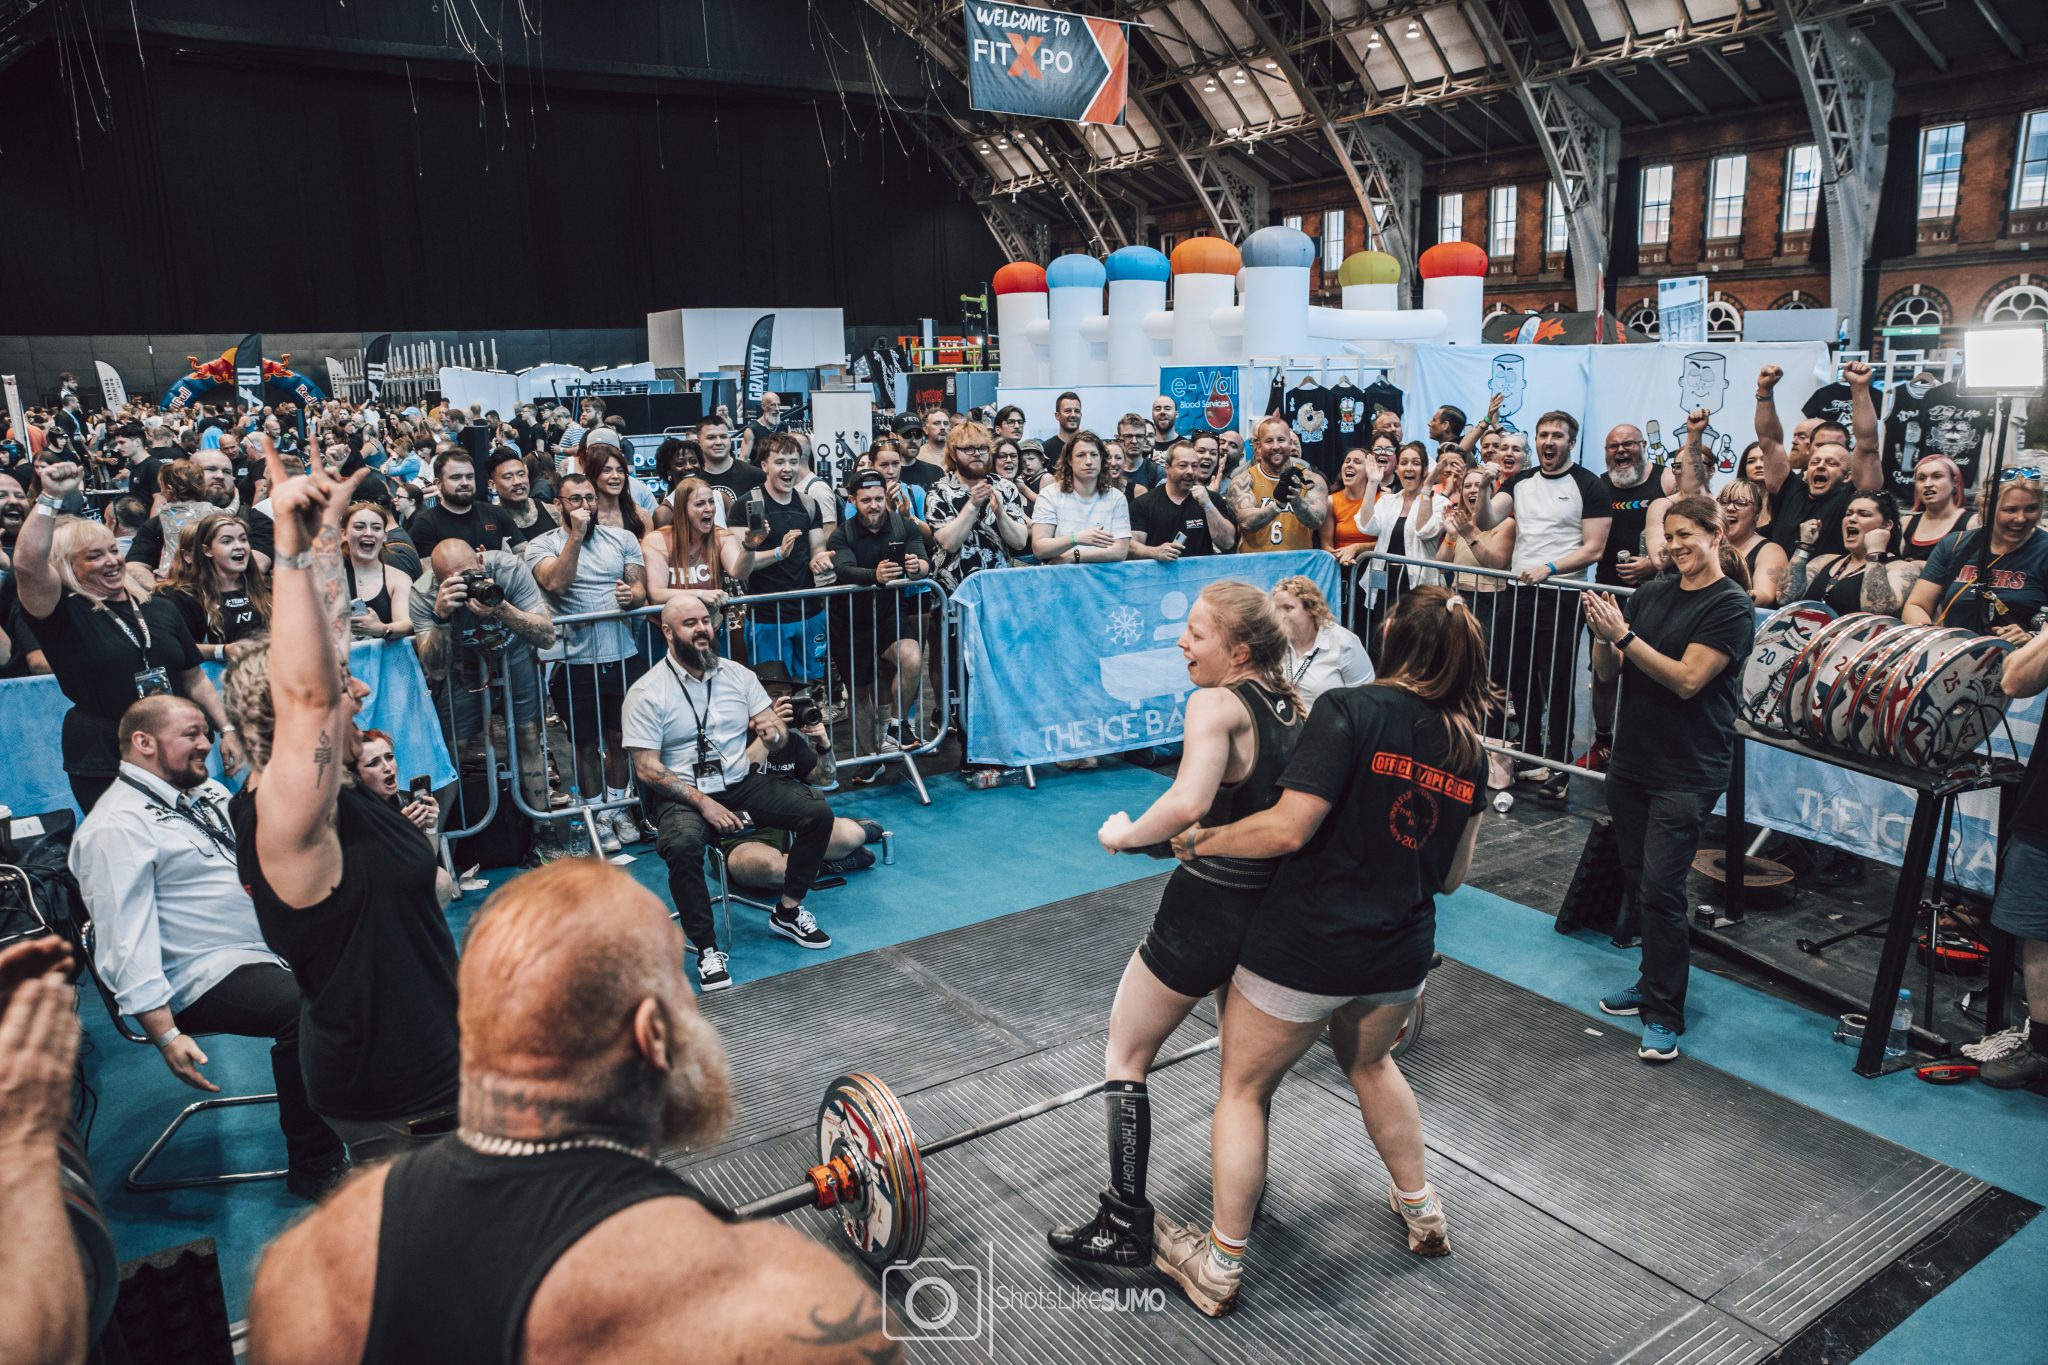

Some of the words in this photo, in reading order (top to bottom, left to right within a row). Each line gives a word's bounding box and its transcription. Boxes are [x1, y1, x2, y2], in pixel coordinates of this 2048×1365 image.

[977, 6, 1050, 32] WELCOME
[1054, 15, 1071, 36] TO
[973, 32, 1073, 80] FITXPO
[749, 344, 766, 401] GRAVITY
[1171, 370, 1238, 397] e-Val
[1202, 400, 1229, 408] Services
[1271, 521, 1283, 545] 6
[1757, 647, 1777, 665] 20
[1834, 655, 1848, 672] 2
[1943, 671, 1960, 694] 25
[1039, 720, 1092, 752] THE
[1098, 712, 1139, 744] ICE
[1796, 787, 1862, 838] THE
[1121, 1098, 1137, 1120] LIFT
[1122, 1122, 1137, 1182] THROUGH
[1123, 1182, 1135, 1195] IT
